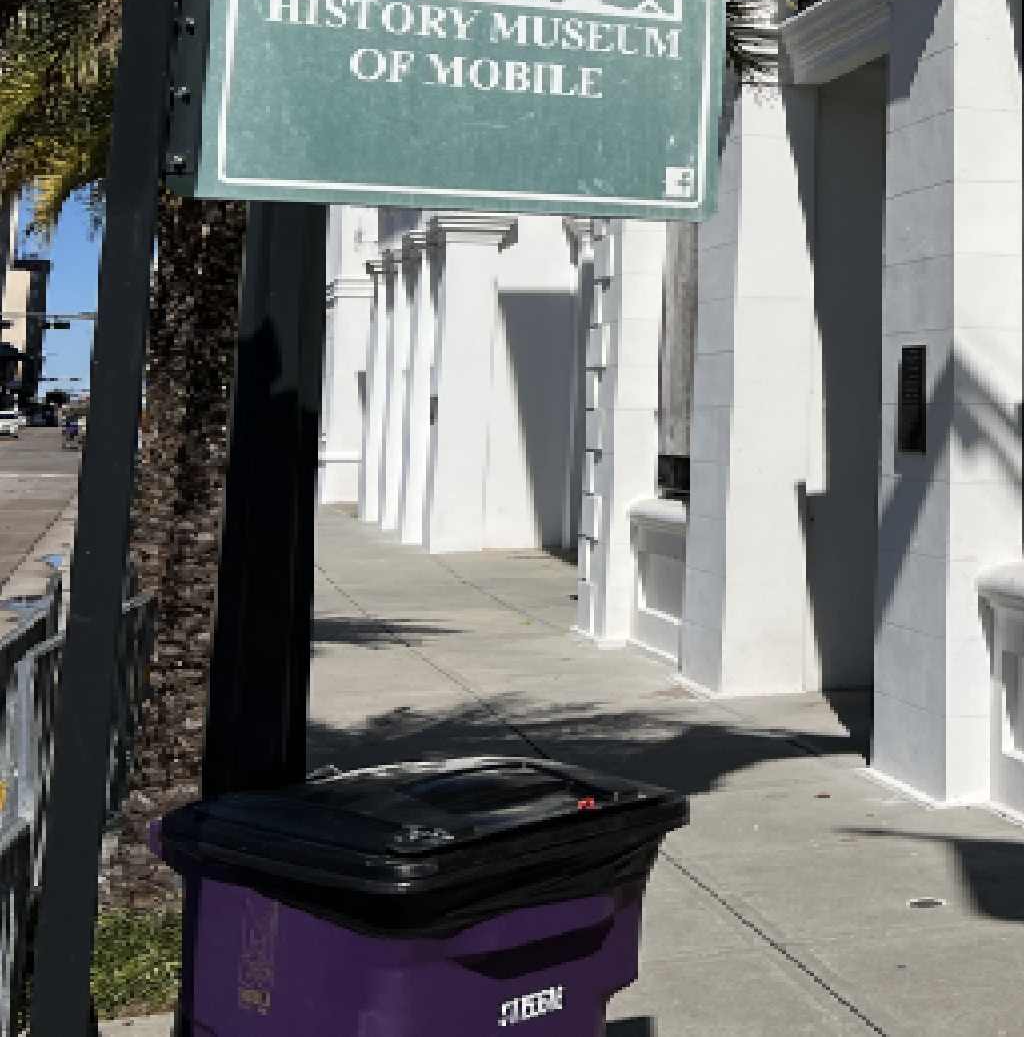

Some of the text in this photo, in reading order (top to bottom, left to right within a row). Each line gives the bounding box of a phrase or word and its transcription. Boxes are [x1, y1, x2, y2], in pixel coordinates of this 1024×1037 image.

[490, 12, 683, 60] MUSEUM
[350, 48, 603, 98] OF MOBILE
